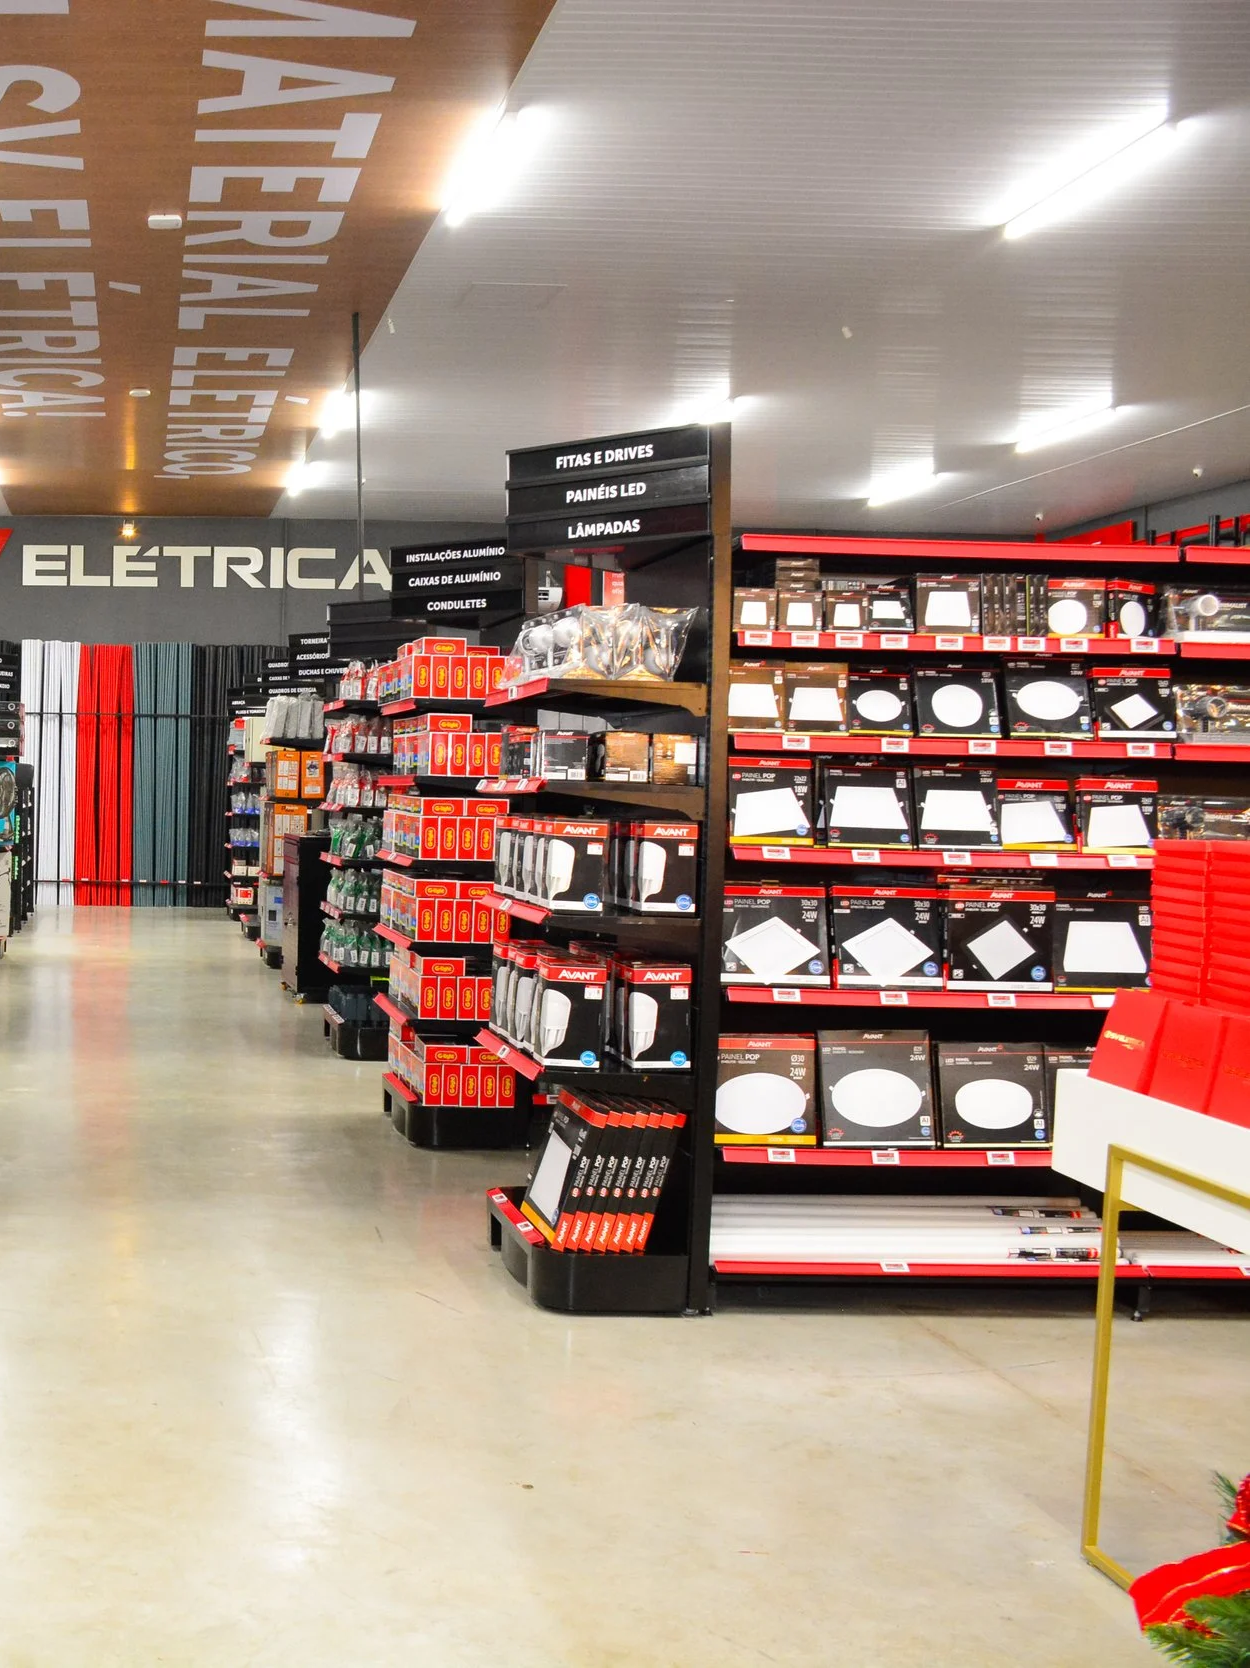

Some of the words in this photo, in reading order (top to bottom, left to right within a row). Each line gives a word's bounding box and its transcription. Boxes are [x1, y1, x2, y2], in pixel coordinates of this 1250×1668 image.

[154, 347, 309, 480] ELÉTRICO,
[556, 452, 591, 470] FITAS
[594, 451, 602, 465] E
[604, 444, 654, 463] DRIVES
[565, 484, 618, 504] PAINÉIS
[620, 481, 647, 498] LED
[568, 518, 640, 540] LÂMPADAS
[406, 549, 462, 564] INSTALAÇÕES
[462, 546, 506, 559] ALUMÍNIO
[22, 544, 392, 591] ELÉTRICA
[408, 575, 440, 587] CAIXAS
[441, 574, 452, 585] DE
[453, 571, 501, 584] ALUMÍNIO
[427, 598, 487, 611] CONDULETES
[298, 668, 320, 676] DUCHAS
[1015, 781, 1044, 789] AVANT
[1103, 781, 1134, 790] AVANT
[562, 825, 599, 836] AVANT
[653, 826, 689, 837] AVANT
[800, 899, 818, 907] 30x30
[913, 900, 930, 908] 30x30
[1029, 904, 1047, 912] 30x30
[801, 910, 818, 919] 24W
[914, 912, 930, 921] 24W
[1029, 916, 1046, 925] 24W
[558, 969, 598, 981] AVANT
[643, 971, 682, 982] AVANT
[720, 1053, 745, 1061] PAINEL
[745, 1053, 760, 1061] POP
[909, 1054, 926, 1062] 24W
[789, 1067, 807, 1077] 24W
[556, 1220, 570, 1244] AVANT
